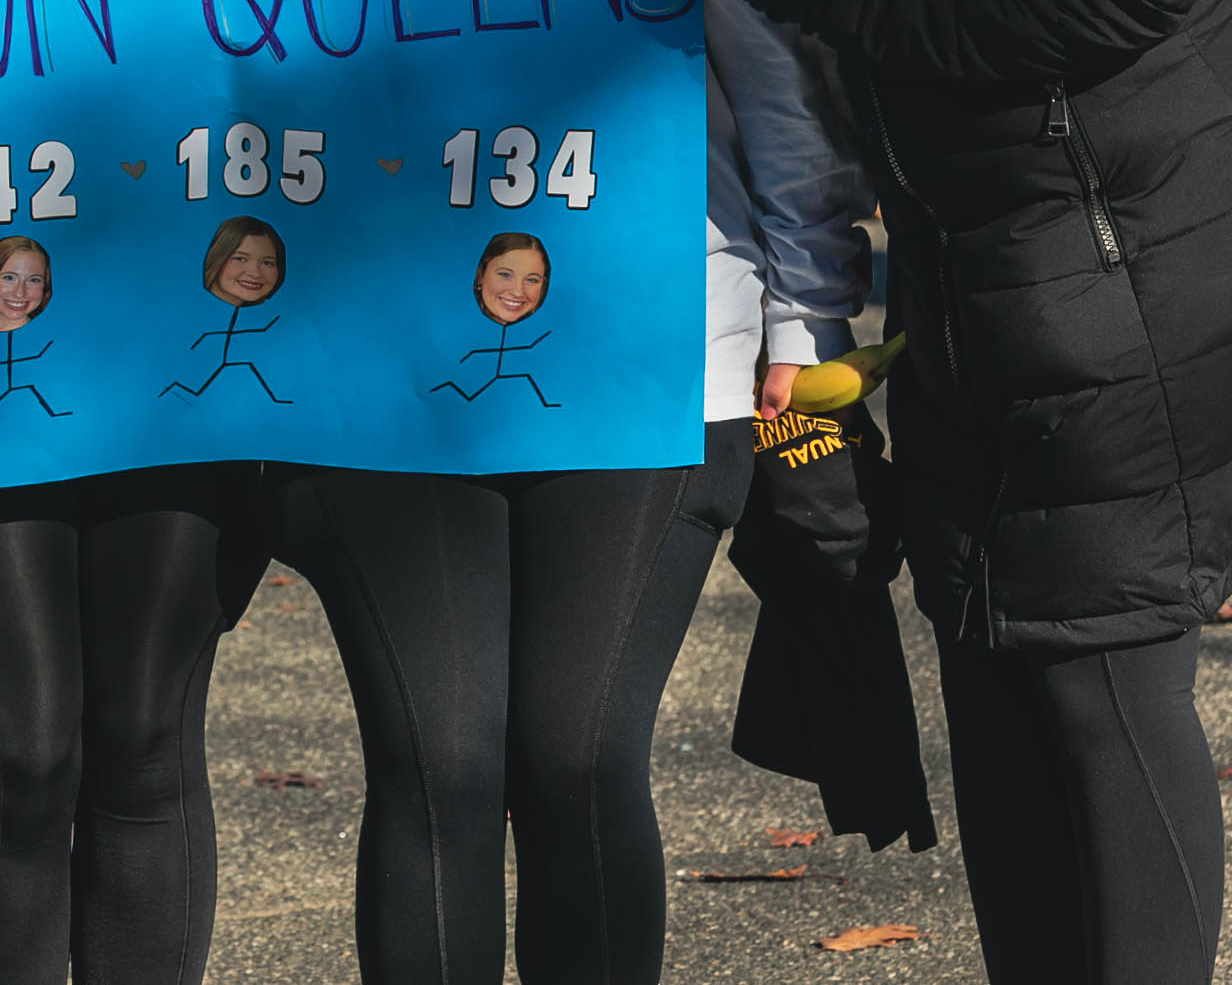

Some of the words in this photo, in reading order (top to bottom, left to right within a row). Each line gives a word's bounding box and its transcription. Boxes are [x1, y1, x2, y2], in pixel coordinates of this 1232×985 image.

[176, 121, 326, 205] 185
[441, 125, 597, 210] 134
[778, 435, 846, 468] NUAL
